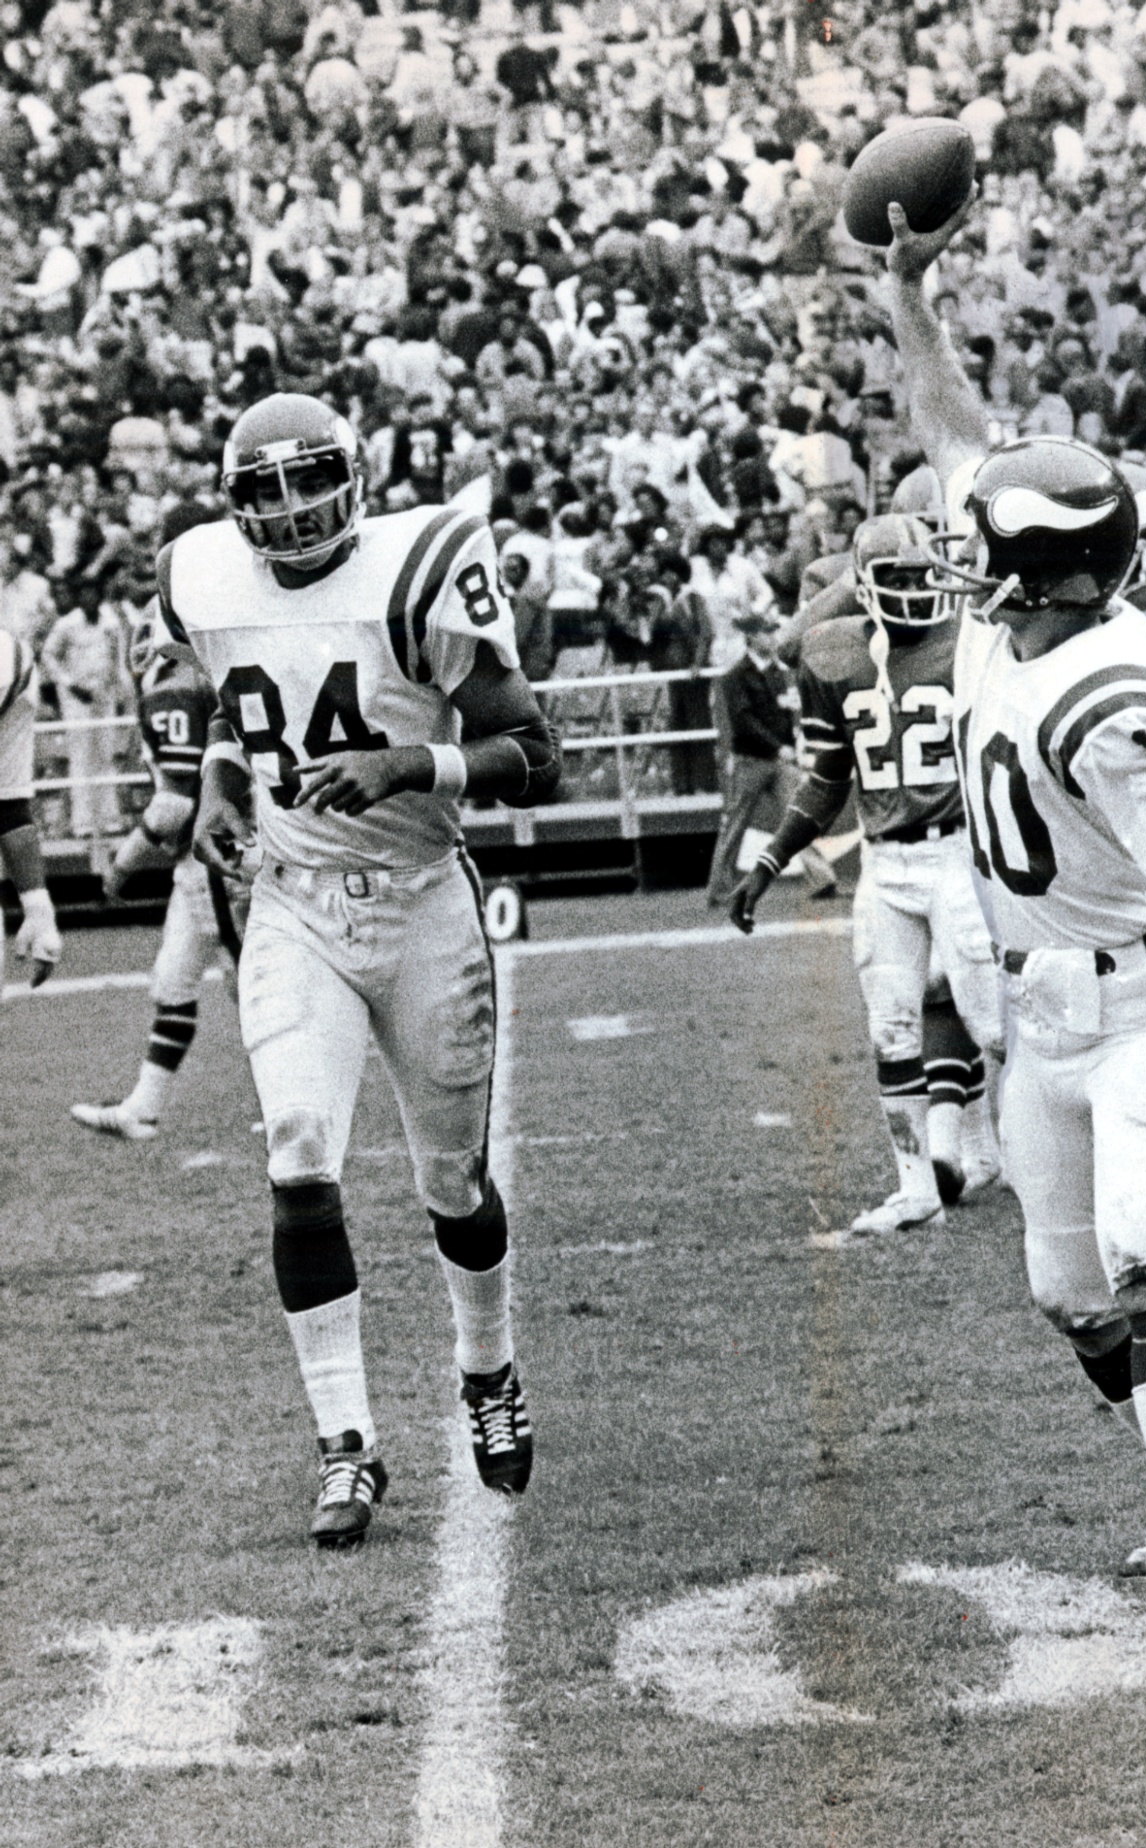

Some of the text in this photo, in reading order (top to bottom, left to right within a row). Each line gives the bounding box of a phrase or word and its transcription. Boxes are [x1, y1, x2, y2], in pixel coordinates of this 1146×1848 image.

[455, 561, 506, 629] 8
[218, 664, 390, 811] 84
[842, 684, 958, 791] 22
